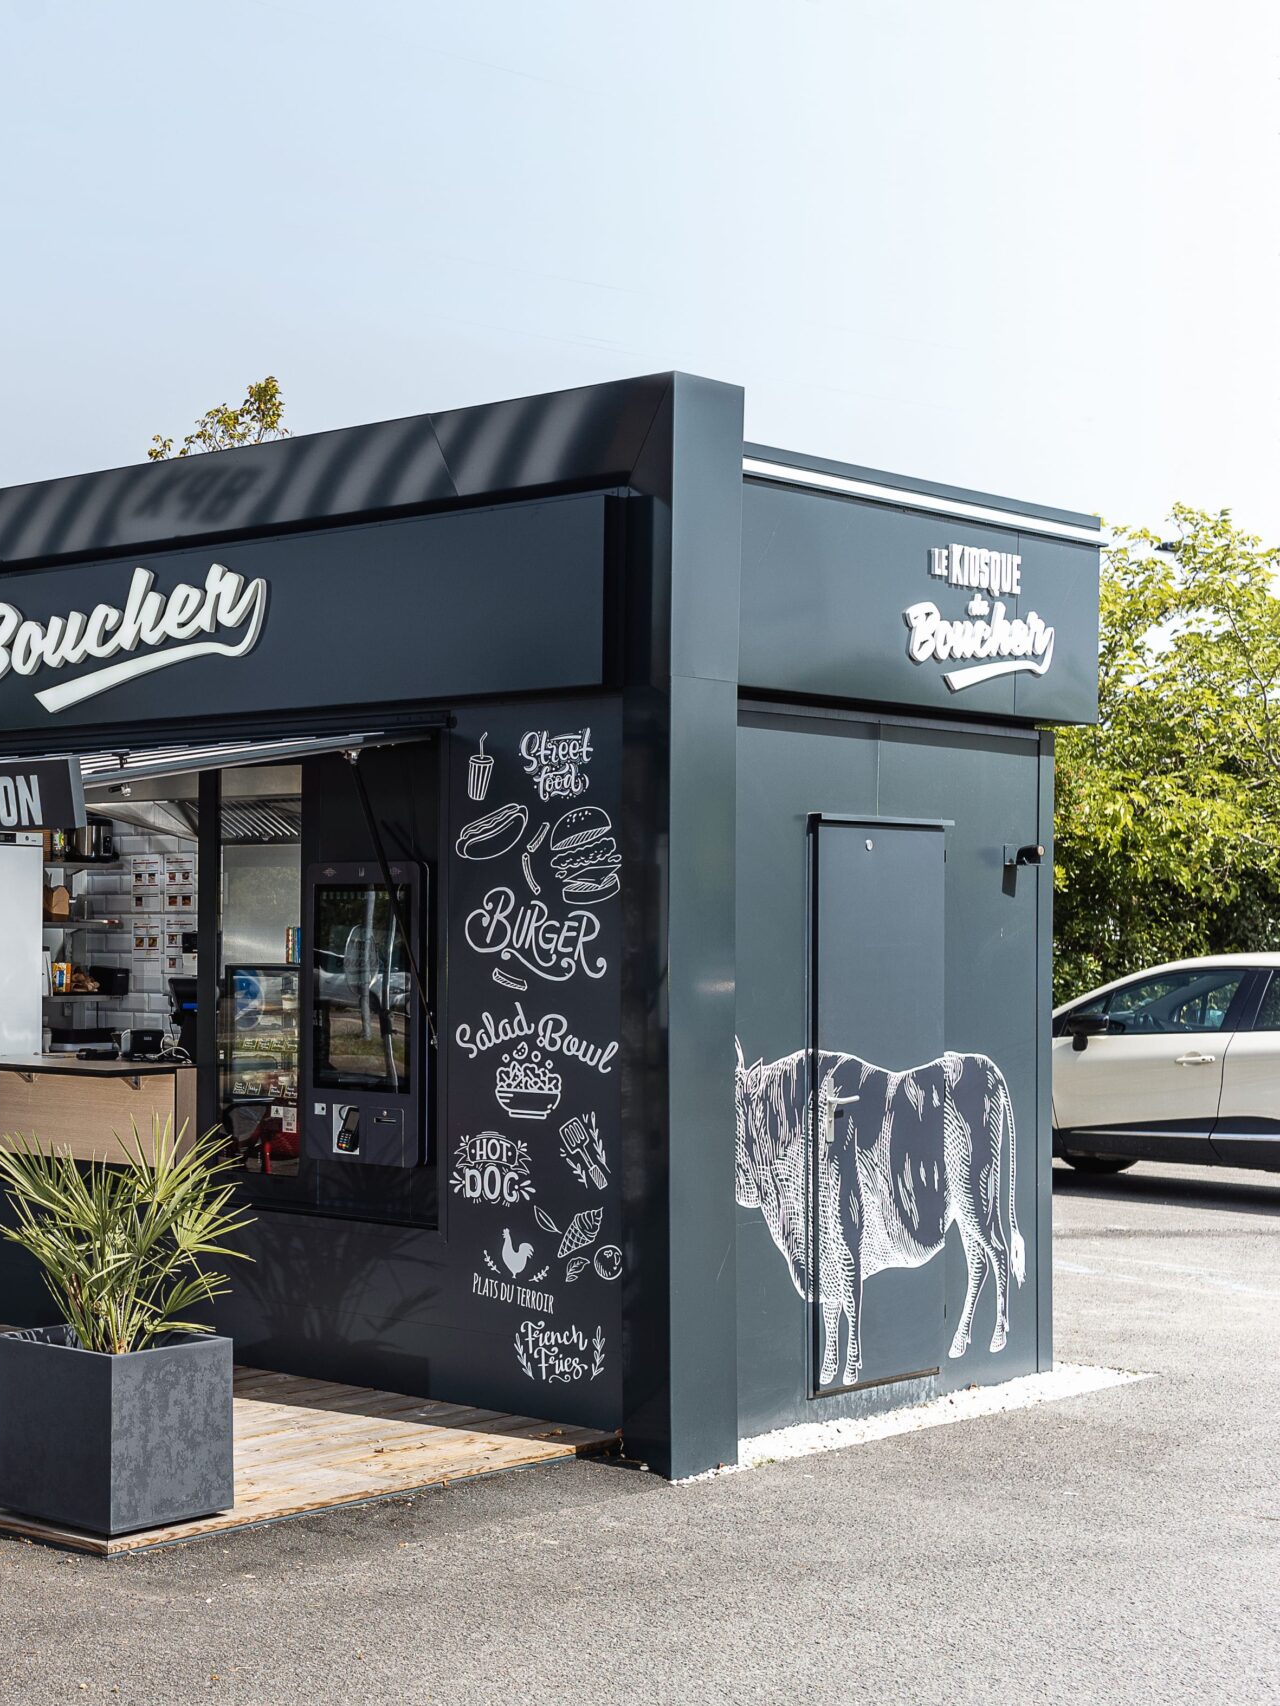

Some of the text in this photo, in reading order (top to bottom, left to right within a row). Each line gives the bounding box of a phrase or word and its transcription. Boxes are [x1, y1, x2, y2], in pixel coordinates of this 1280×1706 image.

[931, 543, 1022, 597] LE KIOSQUE
[904, 601, 1055, 691] Boucher
[520, 727, 593, 773] Street
[532, 764, 583, 802] food
[465, 886, 607, 982] BURGER
[455, 1001, 619, 1073] Salad Bowl
[475, 1140, 510, 1160] HOT
[472, 1272, 554, 1315] PLATS DU TERROIR
[520, 1320, 587, 1355] French
[533, 1346, 588, 1383] Fries
